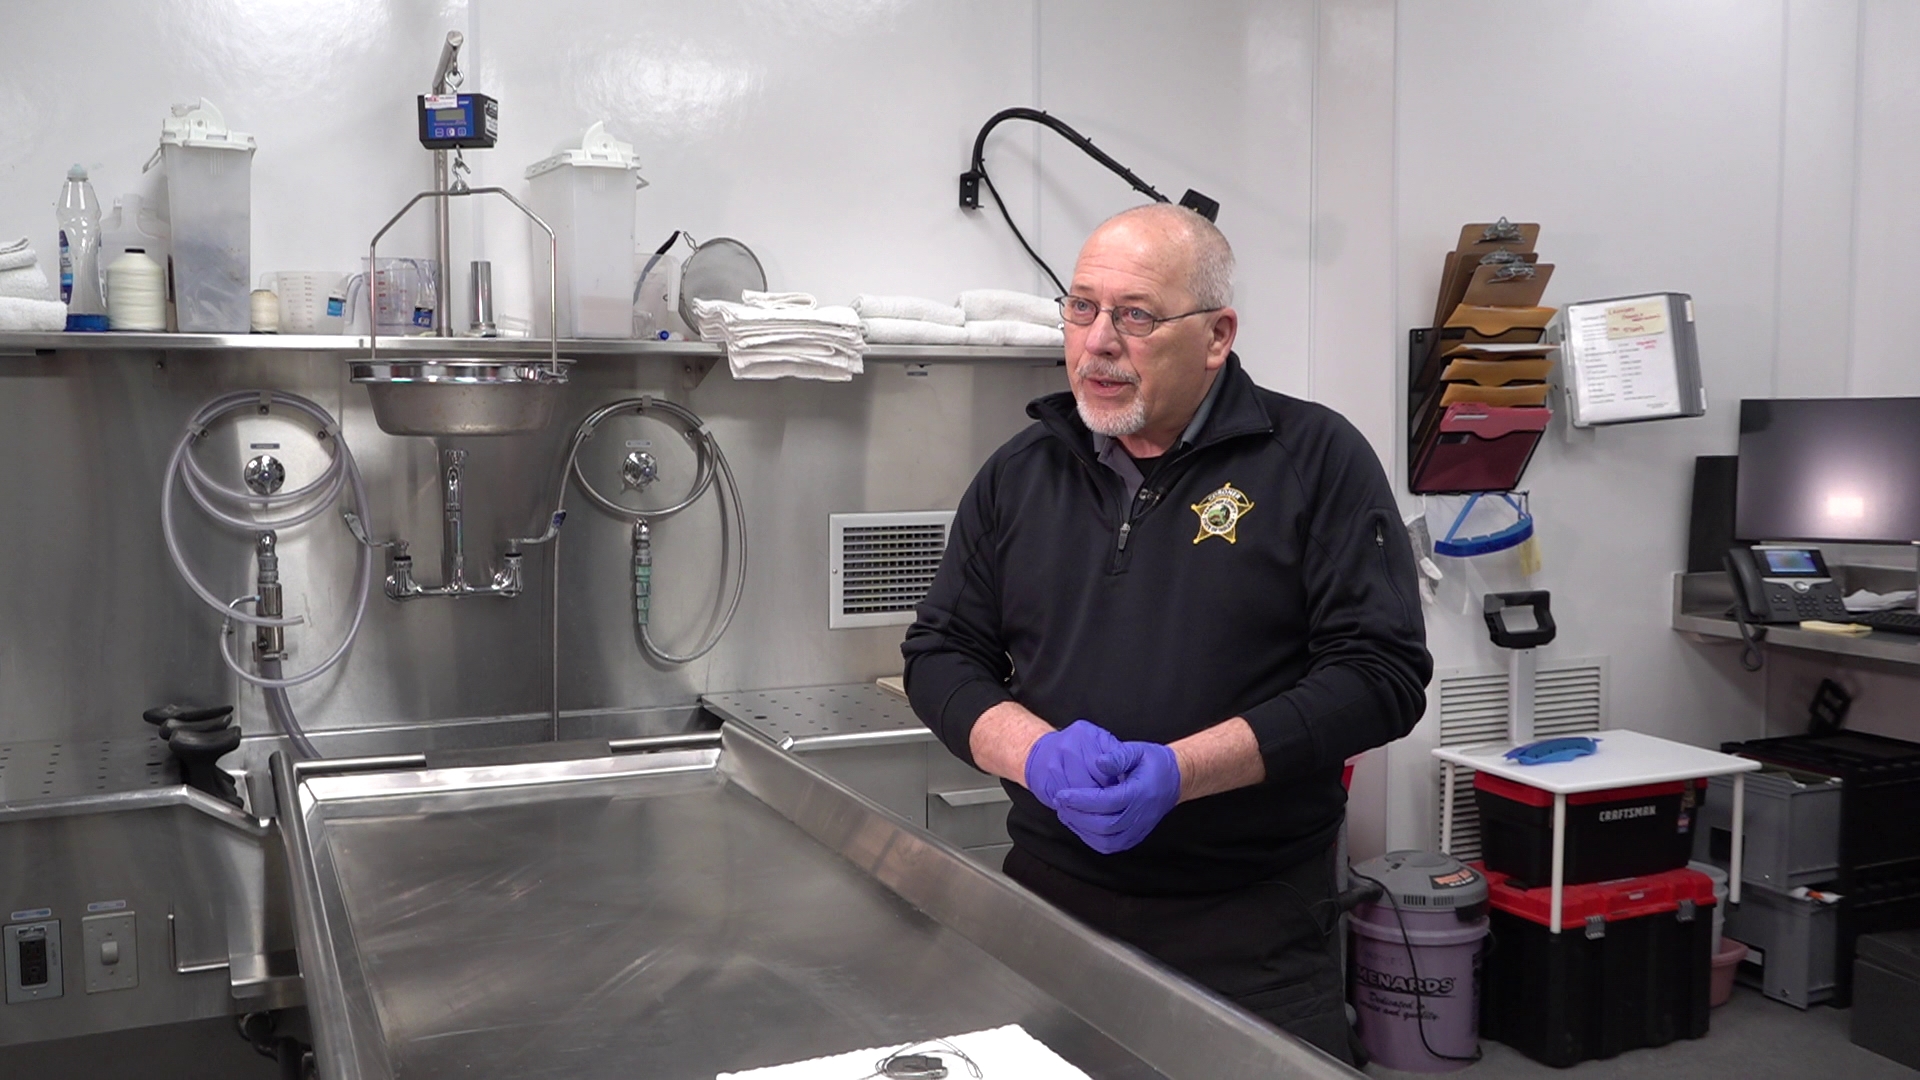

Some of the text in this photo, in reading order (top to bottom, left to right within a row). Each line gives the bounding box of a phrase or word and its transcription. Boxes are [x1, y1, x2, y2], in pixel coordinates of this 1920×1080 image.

[1208, 489, 1241, 500] CORONER
[1599, 805, 1656, 822] CRAFTSMAN
[1356, 965, 1453, 994] MENARDS
[1383, 1007, 1399, 1017] and
